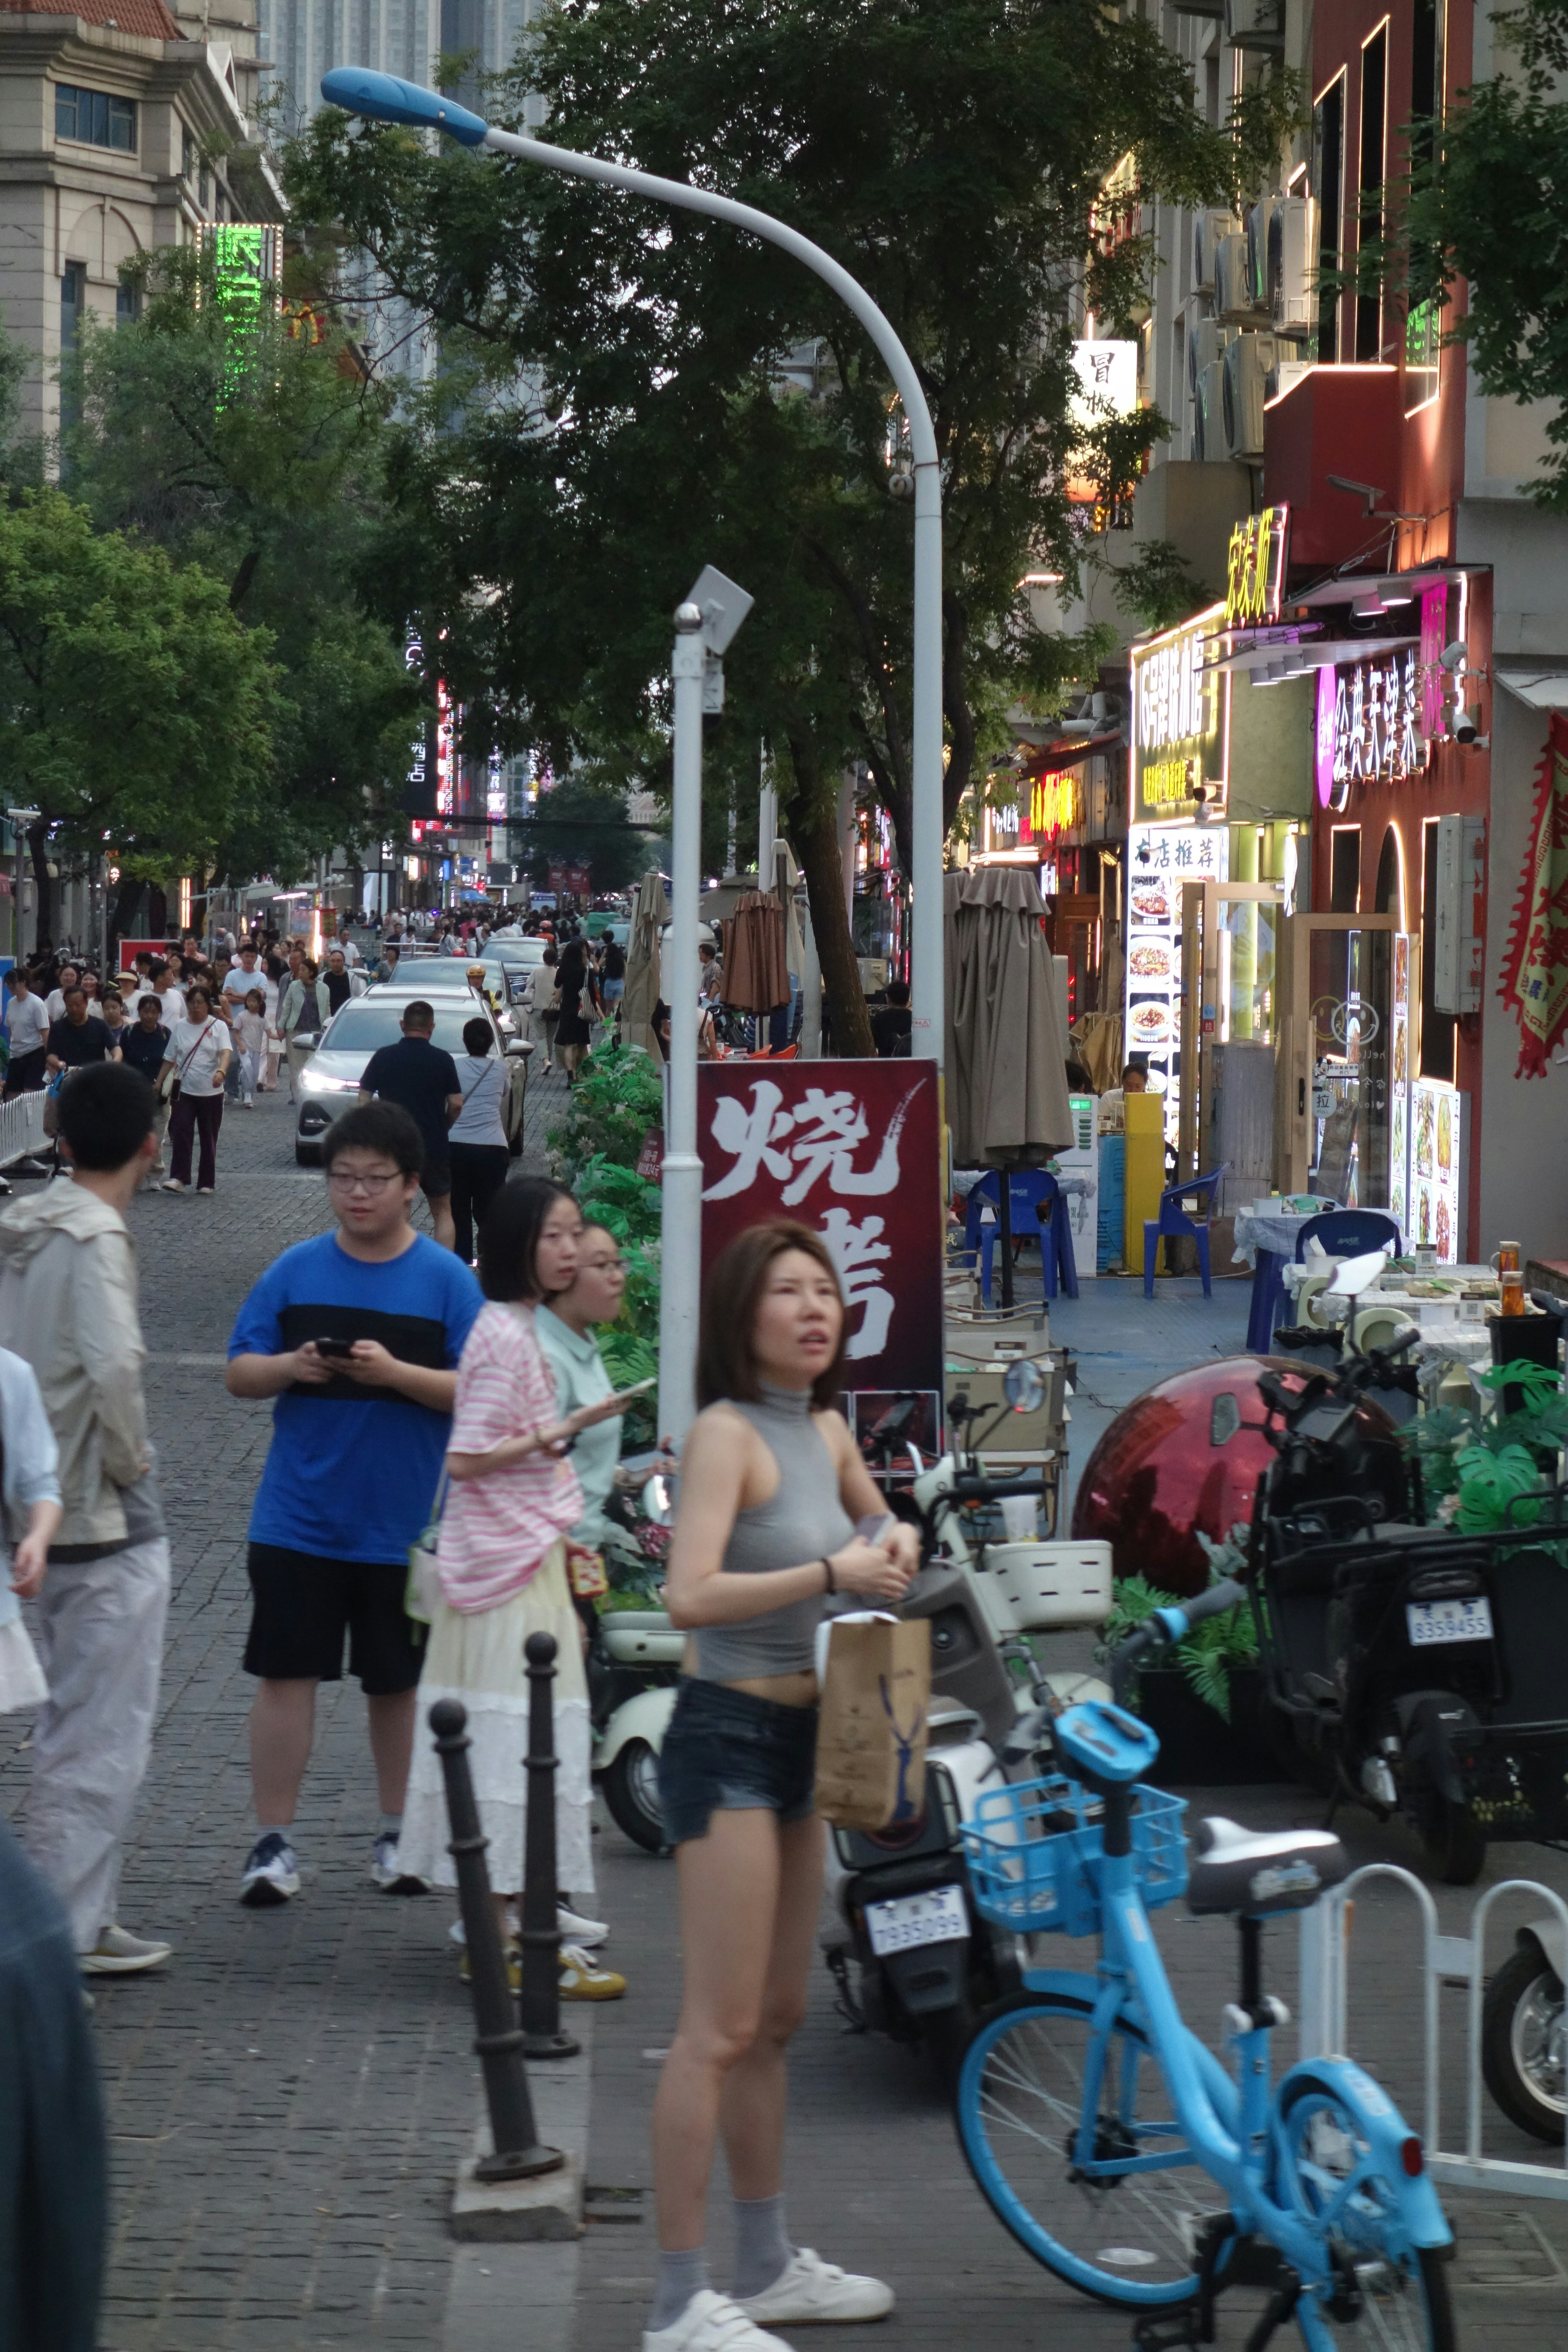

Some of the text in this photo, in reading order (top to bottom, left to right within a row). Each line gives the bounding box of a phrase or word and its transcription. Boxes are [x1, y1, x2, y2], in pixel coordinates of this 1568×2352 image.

[1333, 647, 1416, 781] 经典天津菜
[1135, 837, 1214, 868] 本店推荐
[1316, 1094, 1330, 1108] 拉
